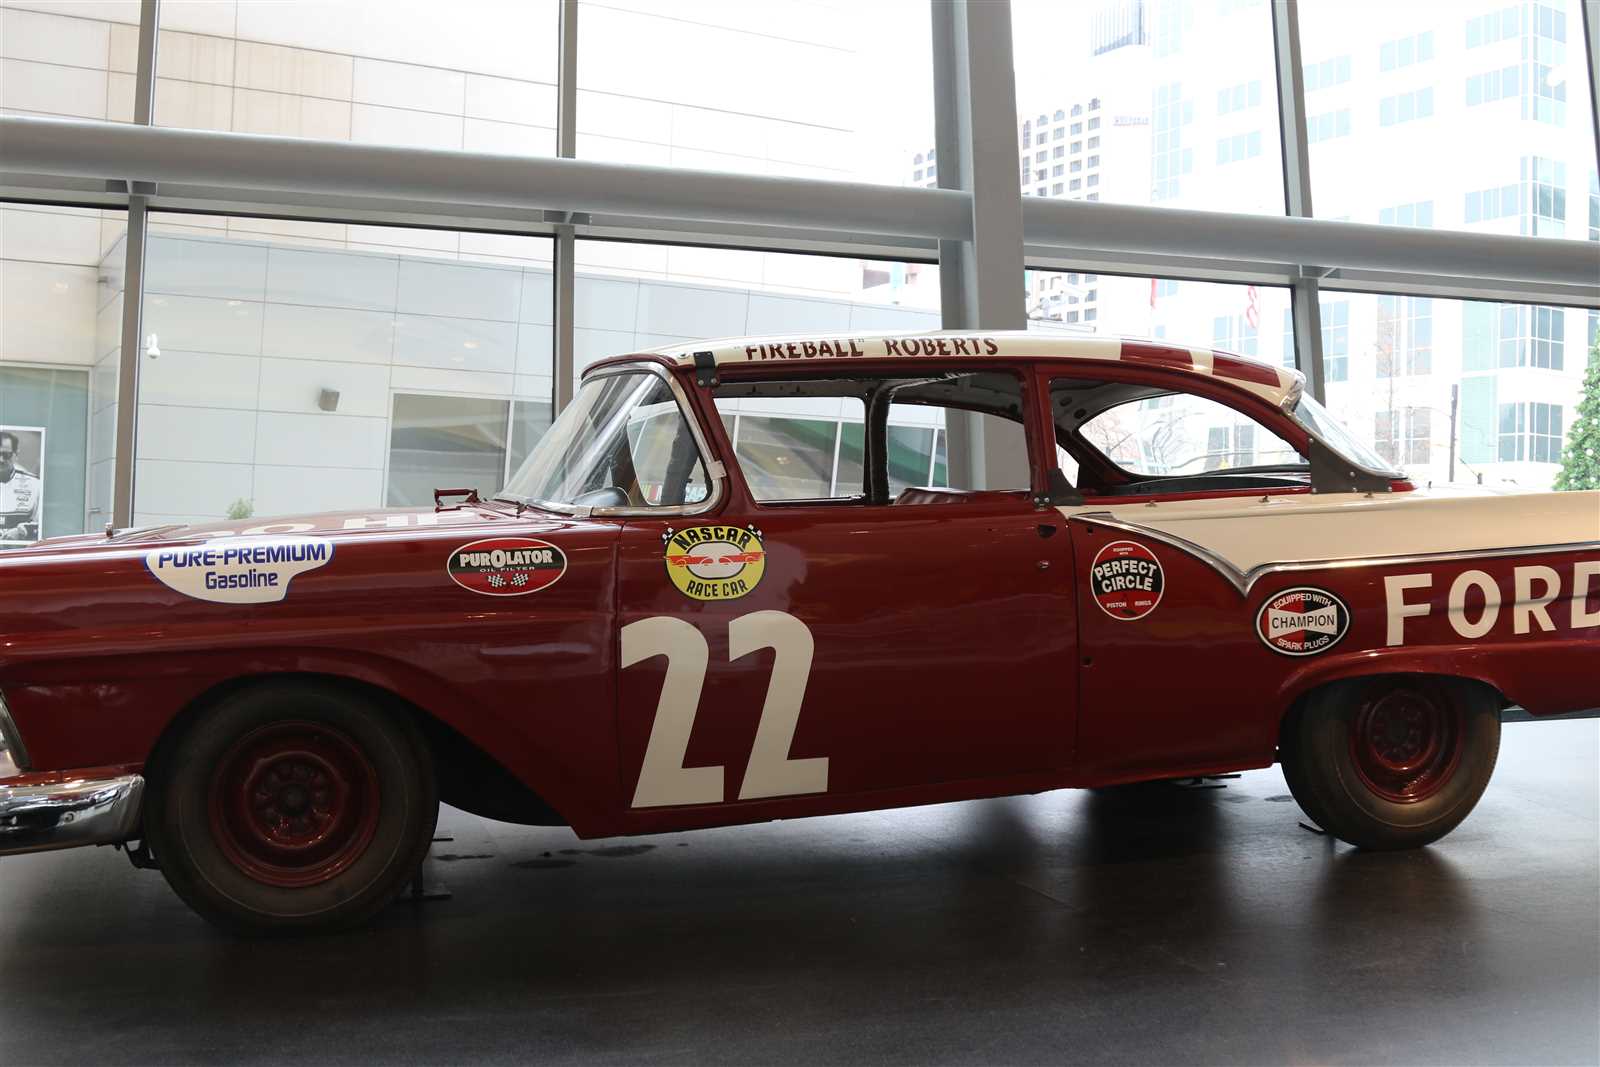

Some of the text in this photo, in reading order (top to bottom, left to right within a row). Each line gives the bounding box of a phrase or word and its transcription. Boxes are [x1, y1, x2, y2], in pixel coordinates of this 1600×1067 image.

[882, 337, 999, 356] ROBERTS
[673, 527, 752, 550] NASCAR
[158, 543, 326, 569] PURE-PREMIUM
[205, 569, 279, 590] Gasoline
[1094, 559, 1157, 581] PERFECT
[686, 580, 748, 597] RACE CAR
[1101, 575, 1154, 593] CIRCLE
[1106, 601, 1127, 609] PISTON
[1273, 593, 1332, 609] EQUIPPED WITH
[1384, 560, 1600, 646] FORD
[1271, 614, 1336, 629] CHAMPION
[1277, 635, 1329, 651] SPARK PLUGS
[620, 609, 830, 809] 22
